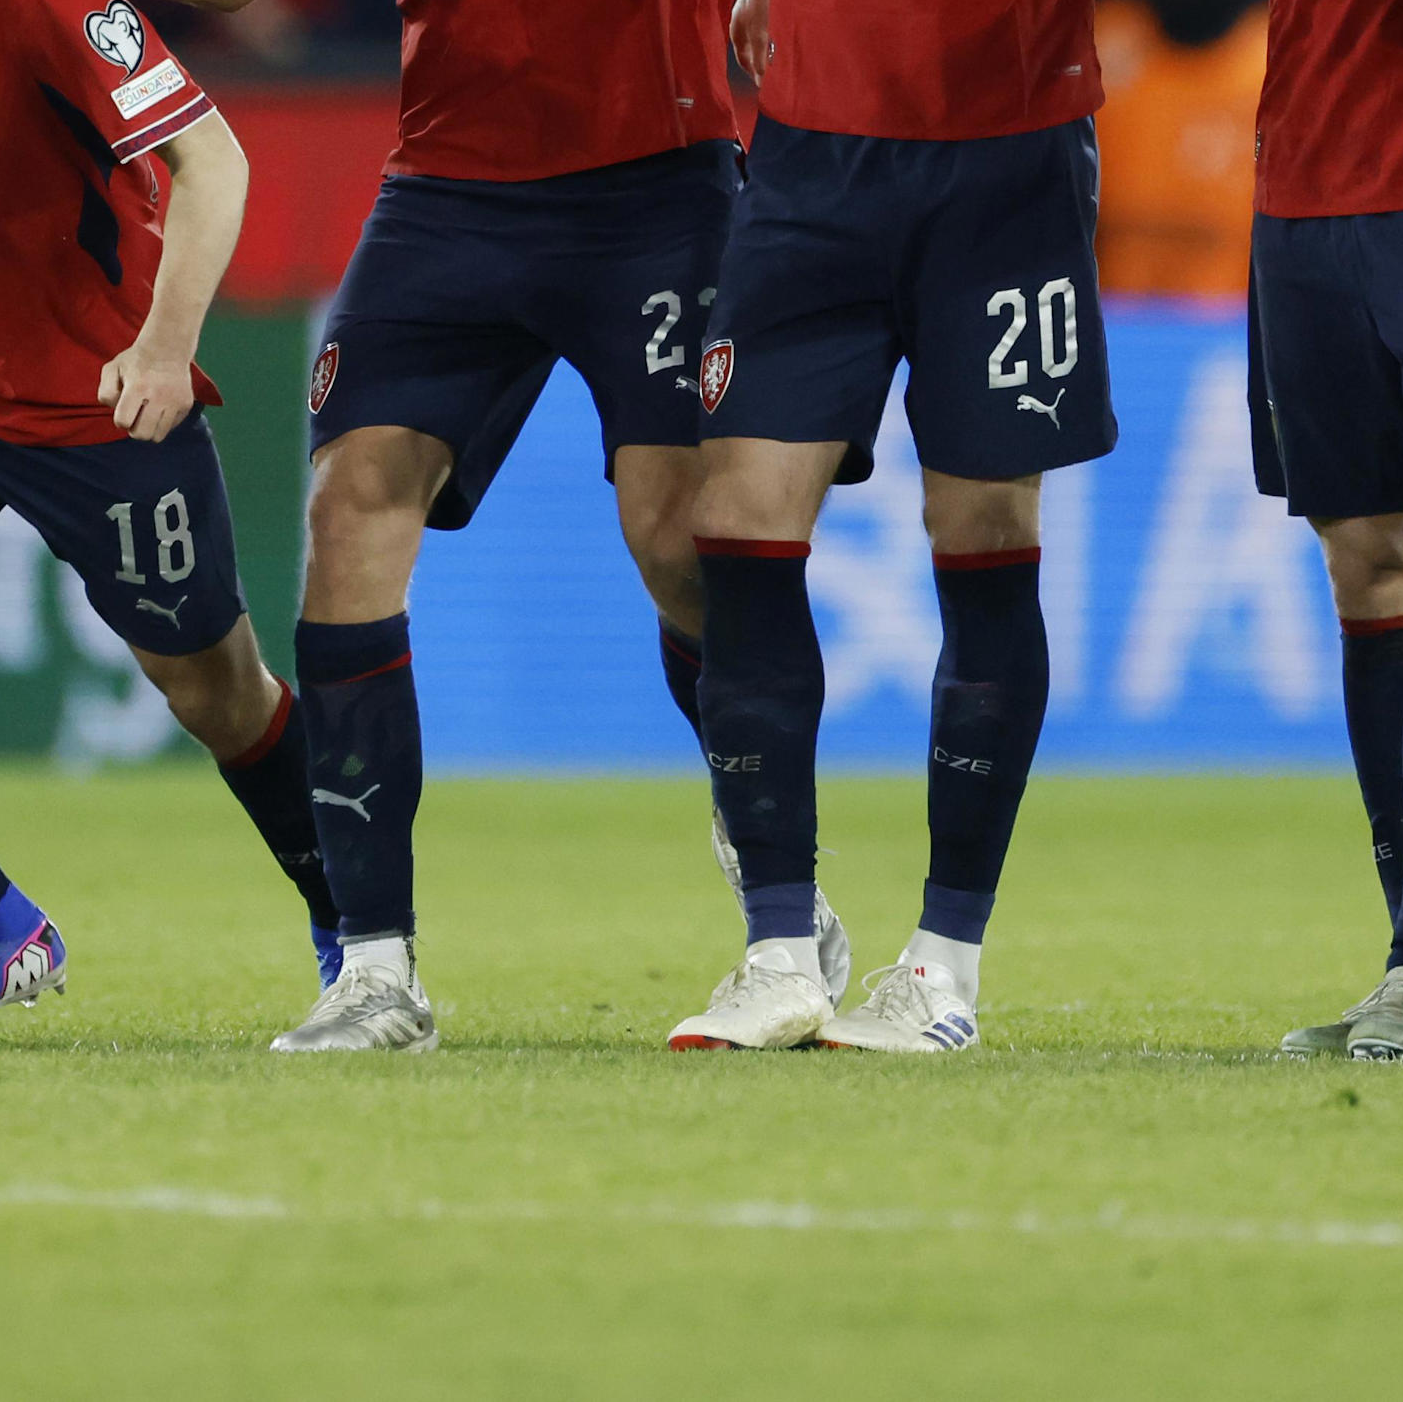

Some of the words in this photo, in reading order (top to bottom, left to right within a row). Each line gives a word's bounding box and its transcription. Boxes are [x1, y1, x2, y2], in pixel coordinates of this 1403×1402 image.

[986, 276, 1079, 390] 20
[105, 487, 197, 586] 18
[708, 752, 762, 772] CZE
[934, 746, 993, 775] CZE
